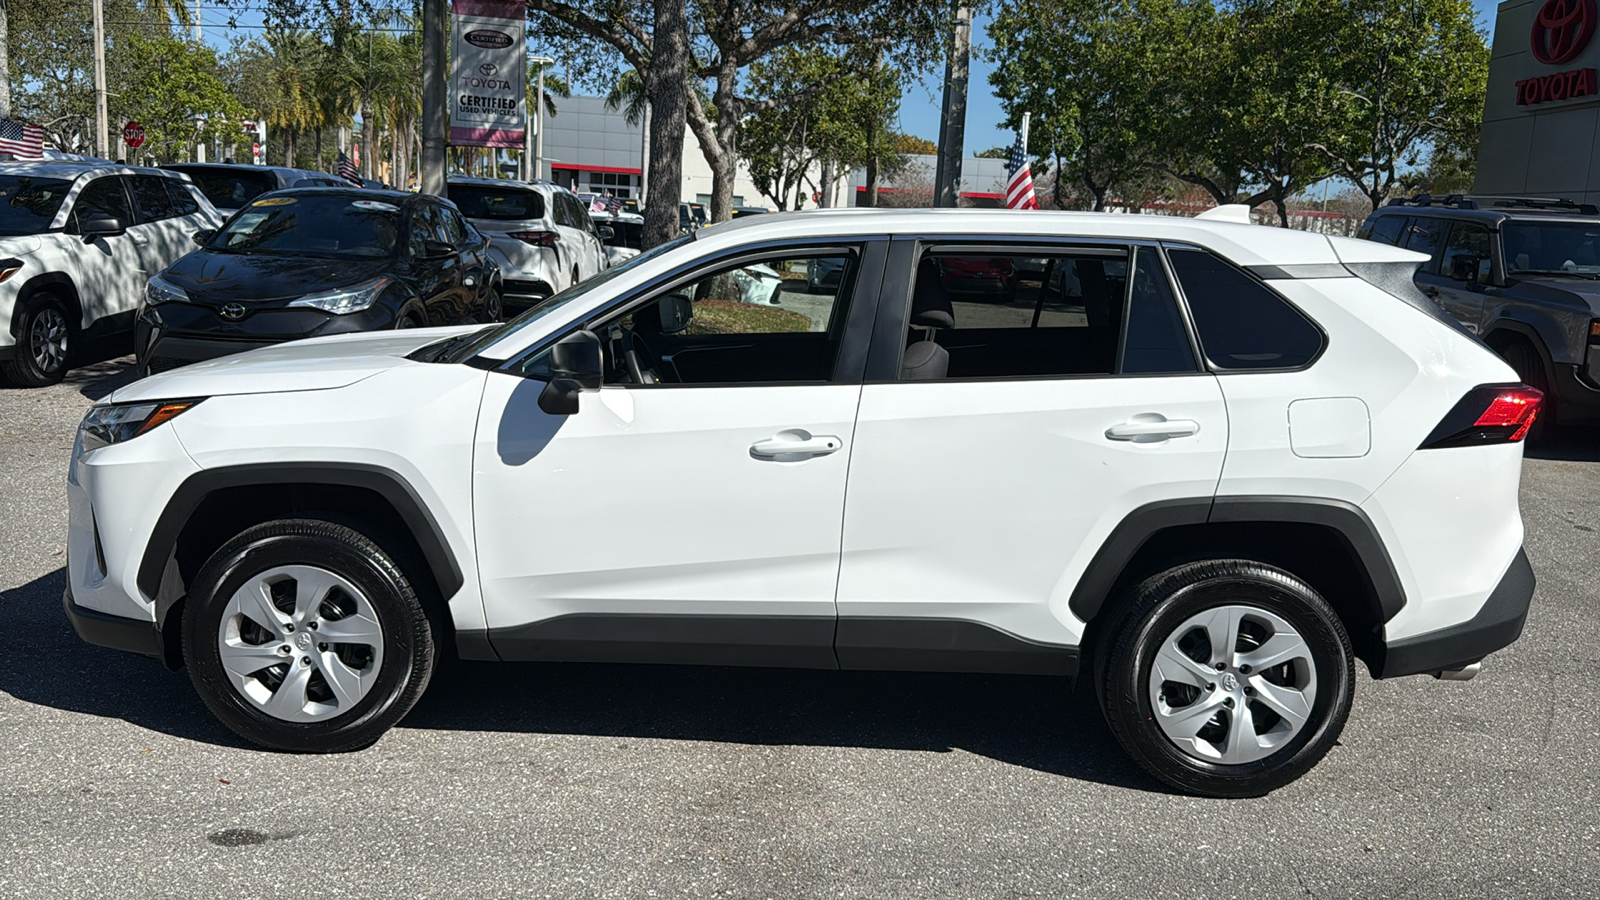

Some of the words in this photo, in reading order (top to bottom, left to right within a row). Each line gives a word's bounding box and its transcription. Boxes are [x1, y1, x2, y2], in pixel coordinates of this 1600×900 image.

[462, 77, 511, 90] TOYOTA
[1515, 68, 1597, 106] TOYOTA
[460, 94, 516, 109] CERTIFIED
[460, 106, 480, 114] USED
[481, 108, 516, 117] VEHICLES
[124, 128, 144, 140] STOP
